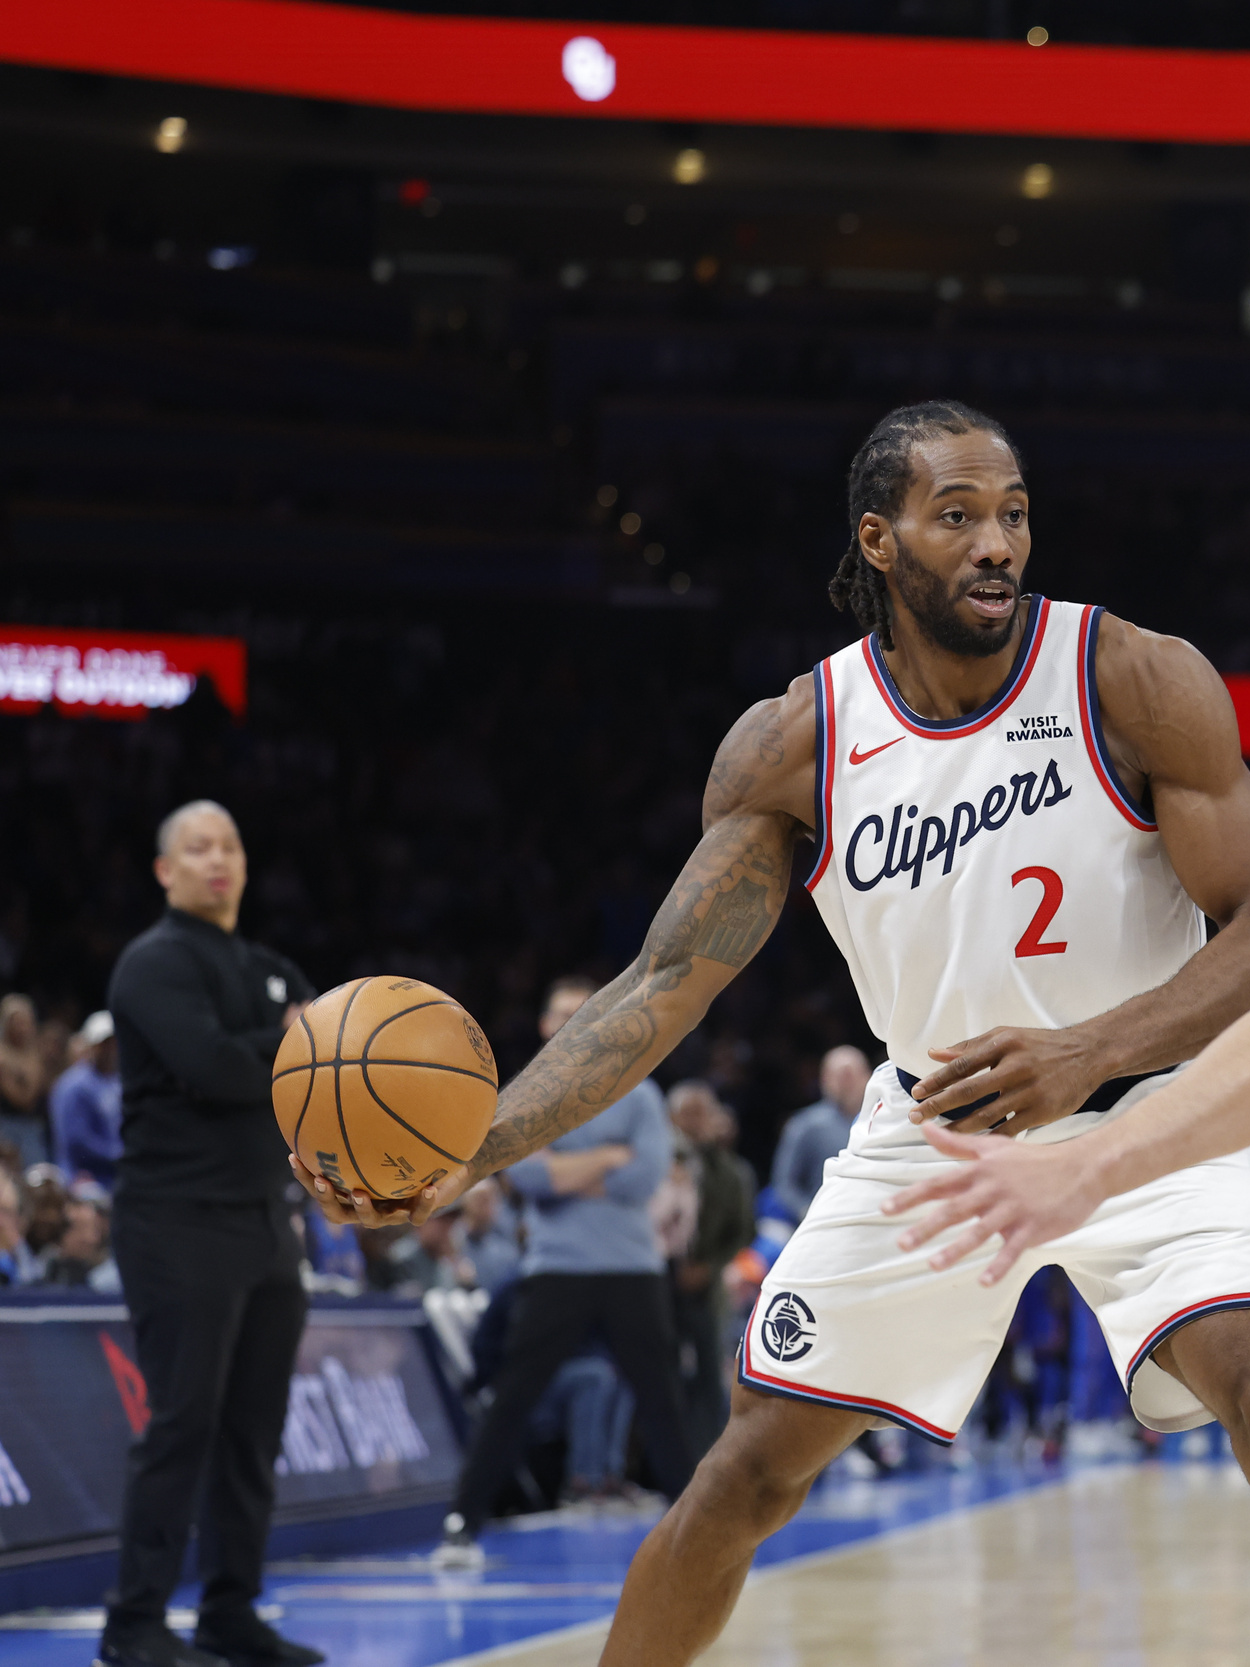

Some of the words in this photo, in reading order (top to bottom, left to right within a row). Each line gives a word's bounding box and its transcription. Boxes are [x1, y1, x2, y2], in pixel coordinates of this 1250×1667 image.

[1006, 727, 1073, 742] RWANDA
[1020, 716, 1058, 728] VISIT
[846, 758, 1073, 892] Clippers
[1011, 865, 1068, 958] 2
